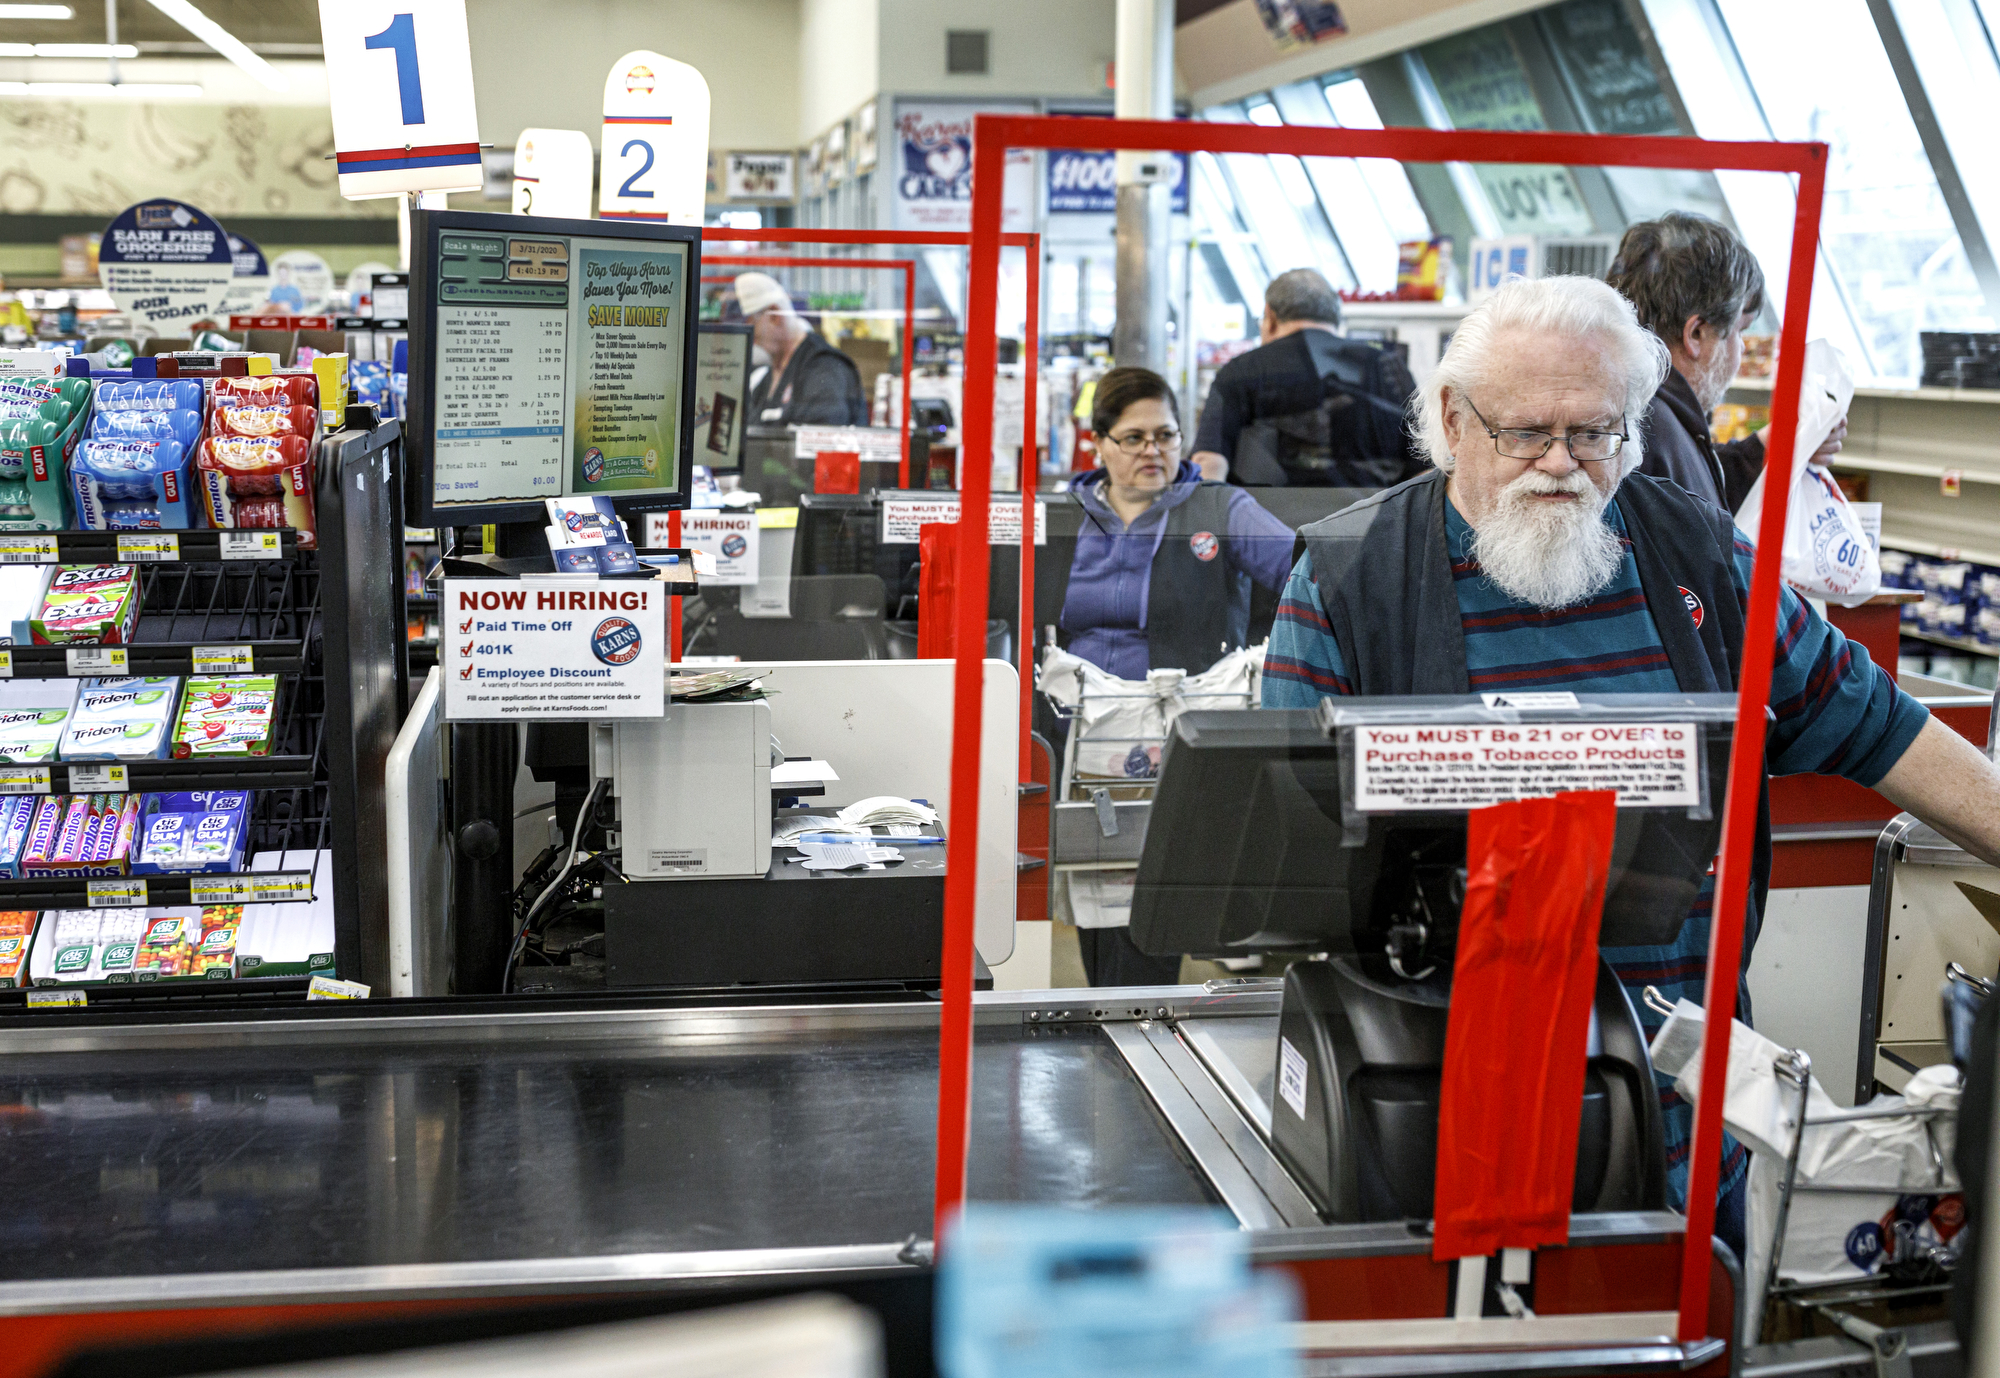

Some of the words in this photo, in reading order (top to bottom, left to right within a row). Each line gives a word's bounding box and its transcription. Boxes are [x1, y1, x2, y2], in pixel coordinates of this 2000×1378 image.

[365, 13, 425, 125] 1
[617, 139, 655, 198] 2
[113, 229, 163, 242] EARN
[168, 230, 216, 242] FREE
[115, 241, 214, 254] GROCERIES
[444, 242, 467, 251] Scale
[471, 243, 499, 252] Weight
[519, 245, 558, 254] 3/31/2020
[516, 267, 546, 275] 4:40:19
[587, 261, 608, 280] Top
[609, 261, 638, 281] Ways
[640, 261, 671, 280] Karns
[1474, 246, 1528, 289] ICE
[583, 281, 615, 300] Saves
[616, 281, 639, 302] You
[640, 281, 674, 298] More!
[132, 296, 170, 310] JOIN
[145, 303, 209, 321] TODAY!
[588, 303, 621, 328] $AVE
[624, 305, 670, 327] MONEY
[619, 333, 637, 341] Specials
[647, 342, 658, 350] Every
[610, 352, 625, 360] Weekly
[595, 363, 610, 371] Weekly
[617, 362, 635, 370] Specials
[593, 405, 613, 413] Tempting
[614, 404, 633, 412] Tuesdays
[607, 414, 628, 422] Discounts
[629, 414, 640, 422] Every
[608, 435, 625, 443] Coupons
[627, 434, 638, 442] Every
[86, 442, 155, 455] mentos
[584, 454, 603, 475] KARNS
[454, 481, 479, 490] Saved
[533, 477, 555, 486] $0.00
[80, 475, 96, 525] mentos
[208, 472, 224, 522] mentos
[889, 505, 909, 513] You
[912, 505, 944, 513] MUST
[568, 514, 581, 526] KARNS
[582, 514, 599, 522] Fresh
[693, 520, 750, 530] HIRING!
[579, 531, 603, 539] REWARDS
[35, 544, 51, 554] 3.45
[155, 543, 171, 553] 3.45
[1838, 539, 1860, 567] 60
[55, 566, 131, 587] Extra
[460, 591, 527, 610] NOW
[537, 591, 647, 610] HIRING!
[42, 601, 121, 621] Extra
[476, 621, 507, 631] Paid
[511, 621, 546, 631] Time
[551, 621, 572, 631] Off
[598, 619, 626, 637] QUALITY
[598, 627, 638, 655] KARNS
[476, 644, 513, 655] 401K
[615, 646, 638, 662] FOODS
[477, 668, 545, 680] Employee
[550, 667, 611, 678] Discount
[488, 681, 510, 689] variety
[84, 691, 139, 707] Trident
[190, 699, 214, 713] AIR
[231, 695, 270, 706] HEADS
[501, 695, 538, 704] application
[236, 705, 267, 713] gum
[73, 724, 128, 740] Trident
[183, 730, 207, 743] AIR
[224, 725, 264, 736] HEADS
[1368, 731, 1409, 743] You
[1417, 730, 1484, 743] MUST
[1491, 730, 1520, 742] Be
[1527, 729, 1551, 741] 21
[1561, 731, 1585, 741] or
[1591, 728, 1656, 741] OVER
[1663, 728, 1684, 740] to
[230, 735, 261, 744] gum
[1366, 749, 1474, 762] Purchase
[1480, 748, 1578, 761] Tobacco
[1586, 747, 1687, 760] Products
[28, 775, 43, 785] 1.19
[216, 801, 237, 809] tac
[31, 803, 56, 853] mentos
[156, 823, 177, 831] tac
[161, 818, 179, 826] tic
[202, 821, 223, 829] tac
[62, 812, 82, 854] mentos
[150, 832, 181, 841] GUM
[196, 830, 227, 839] GUM
[26, 865, 121, 877] mentos
[127, 888, 141, 898] 1.39
[229, 884, 244, 895] 1.39
[288, 882, 303, 892] 1.19
